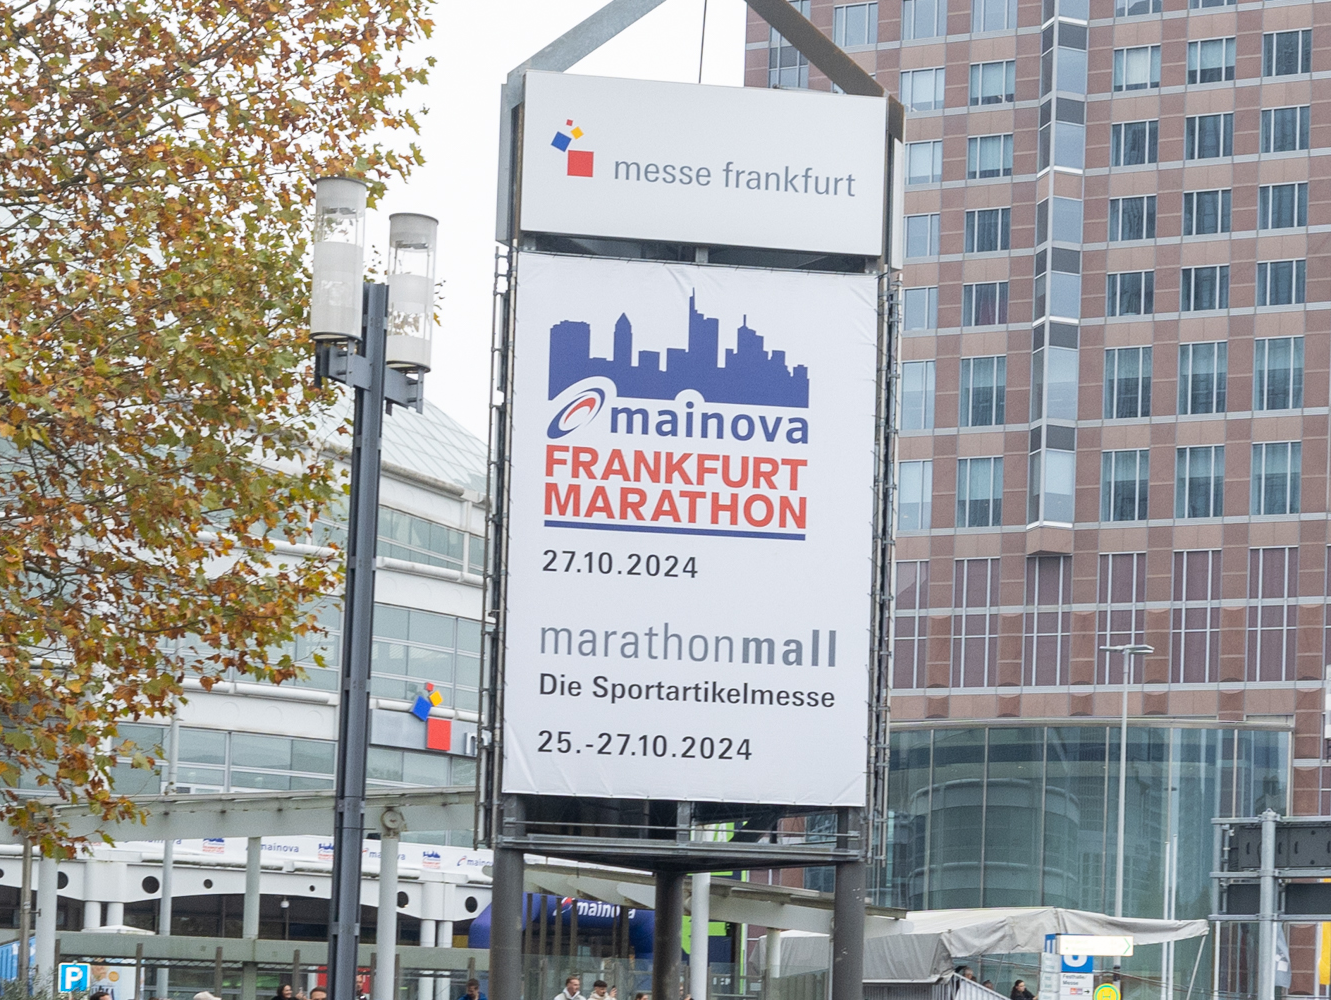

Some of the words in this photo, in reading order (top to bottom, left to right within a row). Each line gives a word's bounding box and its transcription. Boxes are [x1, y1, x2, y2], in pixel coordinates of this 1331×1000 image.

[613, 159, 712, 188] messe
[722, 161, 856, 198] frankfurt
[610, 400, 809, 445] mainova
[545, 444, 808, 491] FRANKFURT
[544, 482, 807, 529] MARATHON
[541, 548, 699, 578] 27.10.2024
[540, 622, 837, 667] marathonmall
[538, 672, 582, 697] Die
[592, 675, 836, 708] Sportartikelmesse
[537, 729, 752, 761] 25.-27.10.2024
[65, 967, 83, 989] P
